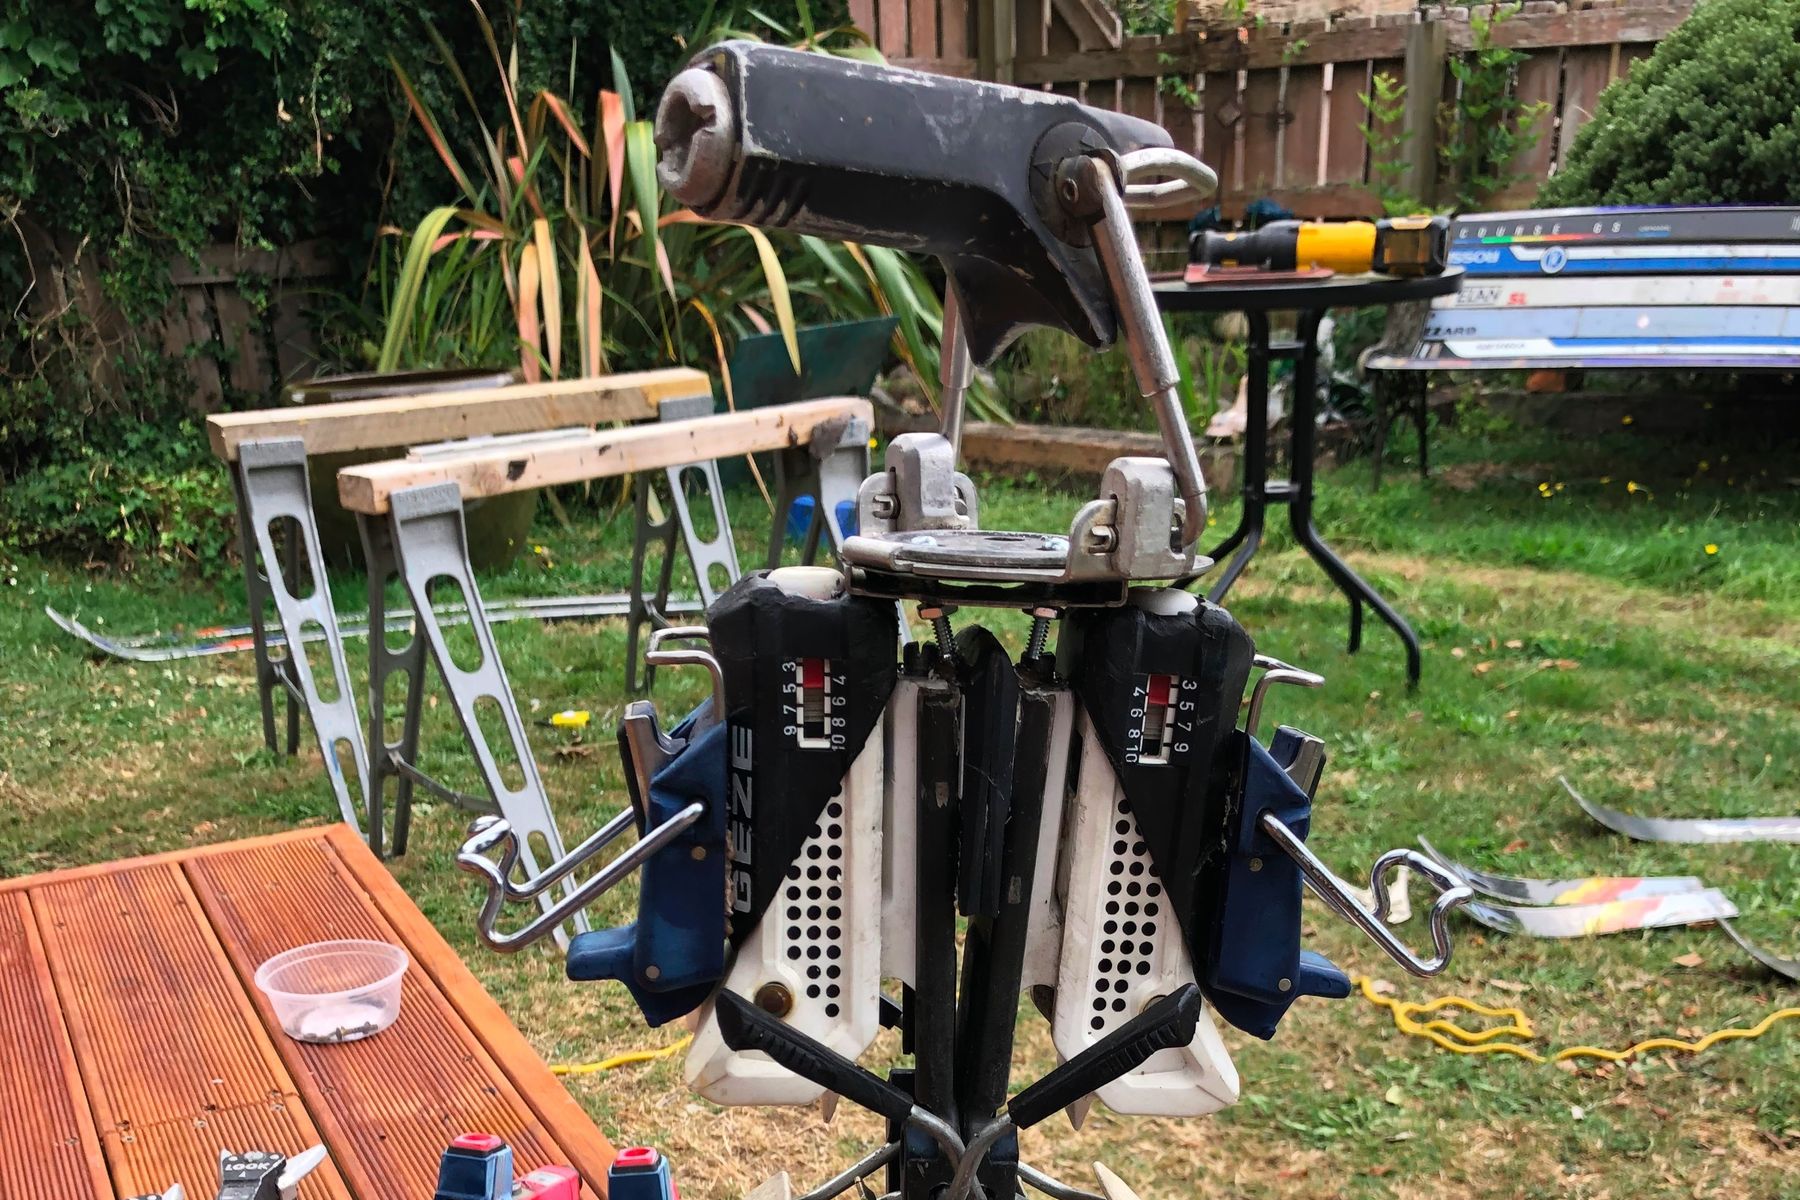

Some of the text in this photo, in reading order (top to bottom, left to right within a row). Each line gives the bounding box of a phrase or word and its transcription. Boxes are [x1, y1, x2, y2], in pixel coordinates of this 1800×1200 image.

[782, 661, 797, 736] 9 7 5 3
[831, 675, 847, 751] 10 8 6 4
[1125, 686, 1146, 763] 4 6 8 10
[1174, 680, 1198, 753] 3 5 7 9
[732, 725, 753, 914] GEZE
[224, 1161, 272, 1172] LOOK
